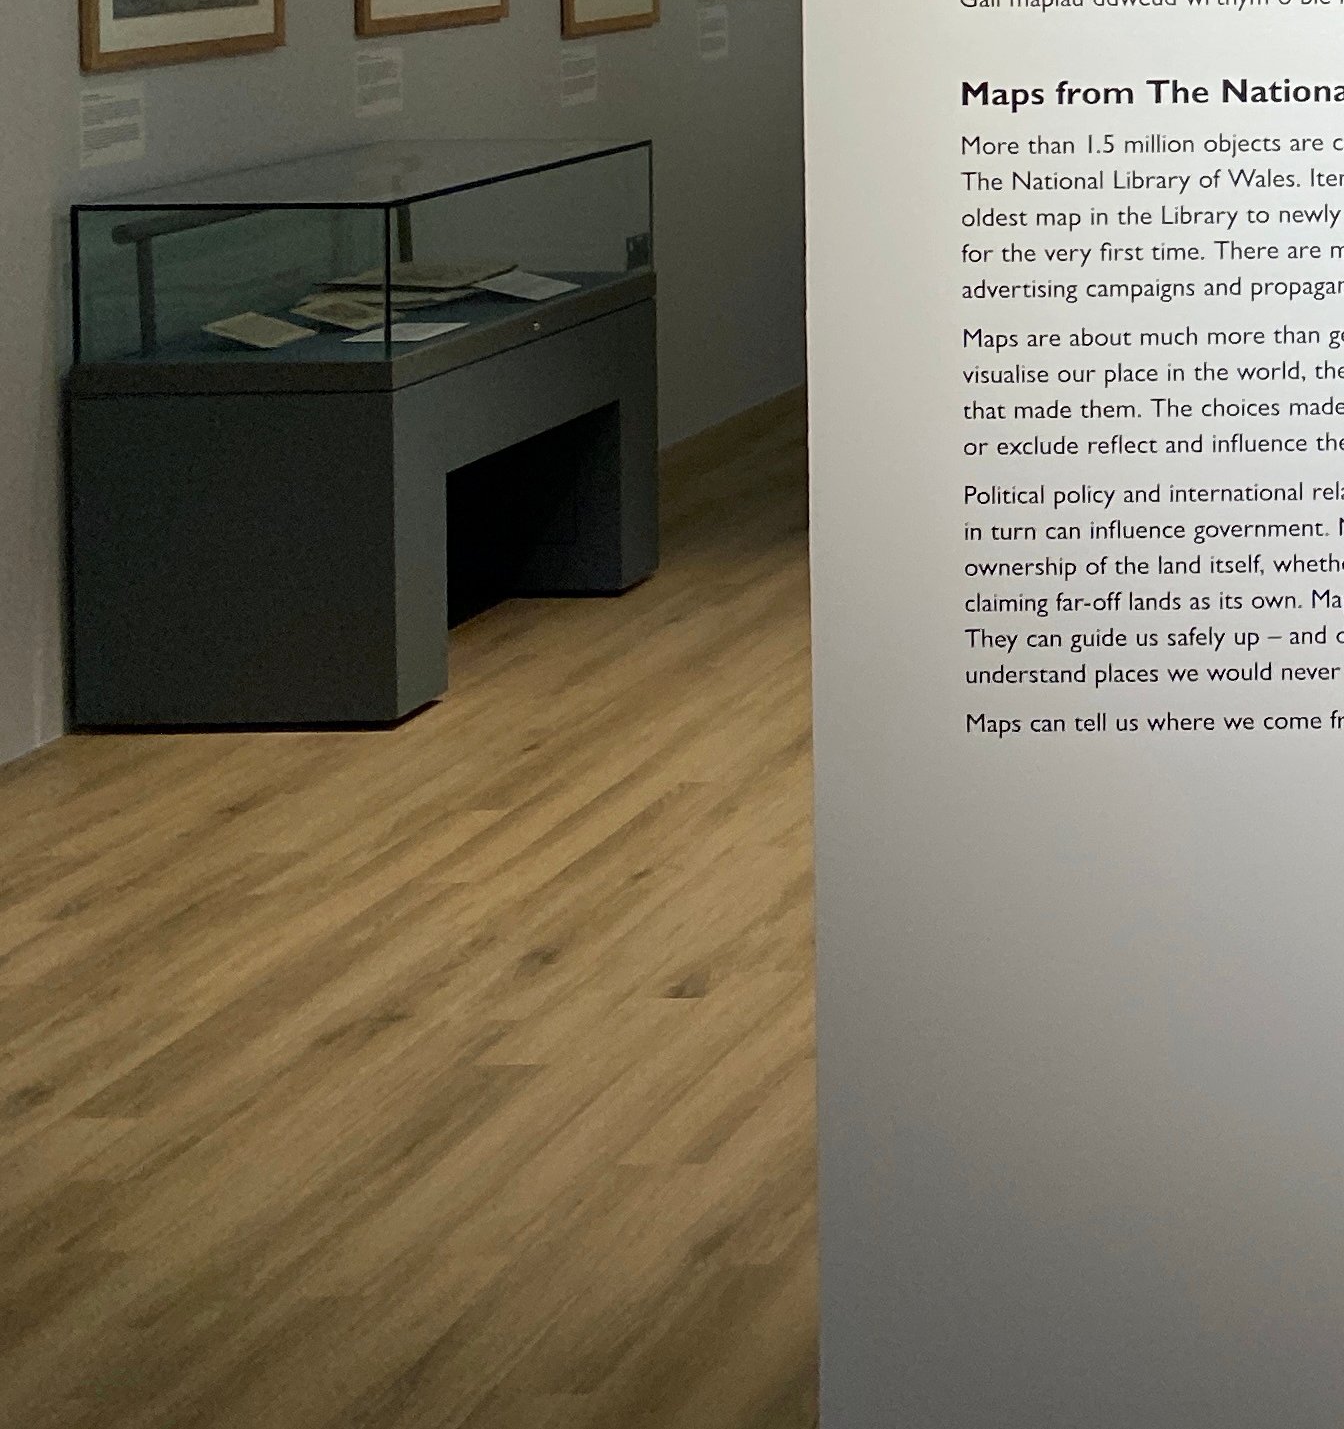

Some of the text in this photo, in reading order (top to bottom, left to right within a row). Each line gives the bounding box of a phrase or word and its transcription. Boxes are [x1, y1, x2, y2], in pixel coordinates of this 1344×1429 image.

[961, 80, 1045, 114] Maps
[1055, 80, 1134, 106] from
[1145, 79, 1209, 105] The
[961, 135, 1020, 156] More
[1027, 134, 1075, 155] than
[1085, 133, 1115, 154] 1.5
[1124, 133, 1195, 154] million
[1203, 132, 1281, 159] objects
[1289, 137, 1324, 152] are
[961, 278, 1079, 304] advertising
[1085, 278, 1196, 304] campaigns
[1203, 275, 1242, 297] and
[964, 484, 1045, 505] Political
[1053, 483, 1116, 511] policy
[1123, 482, 1161, 504] and
[1169, 481, 1303, 503] international
[965, 662, 1086, 685] understand
[1095, 662, 1159, 690] places
[1166, 668, 1199, 683] we
[1206, 660, 1272, 682] would
[1281, 666, 1342, 681] never
